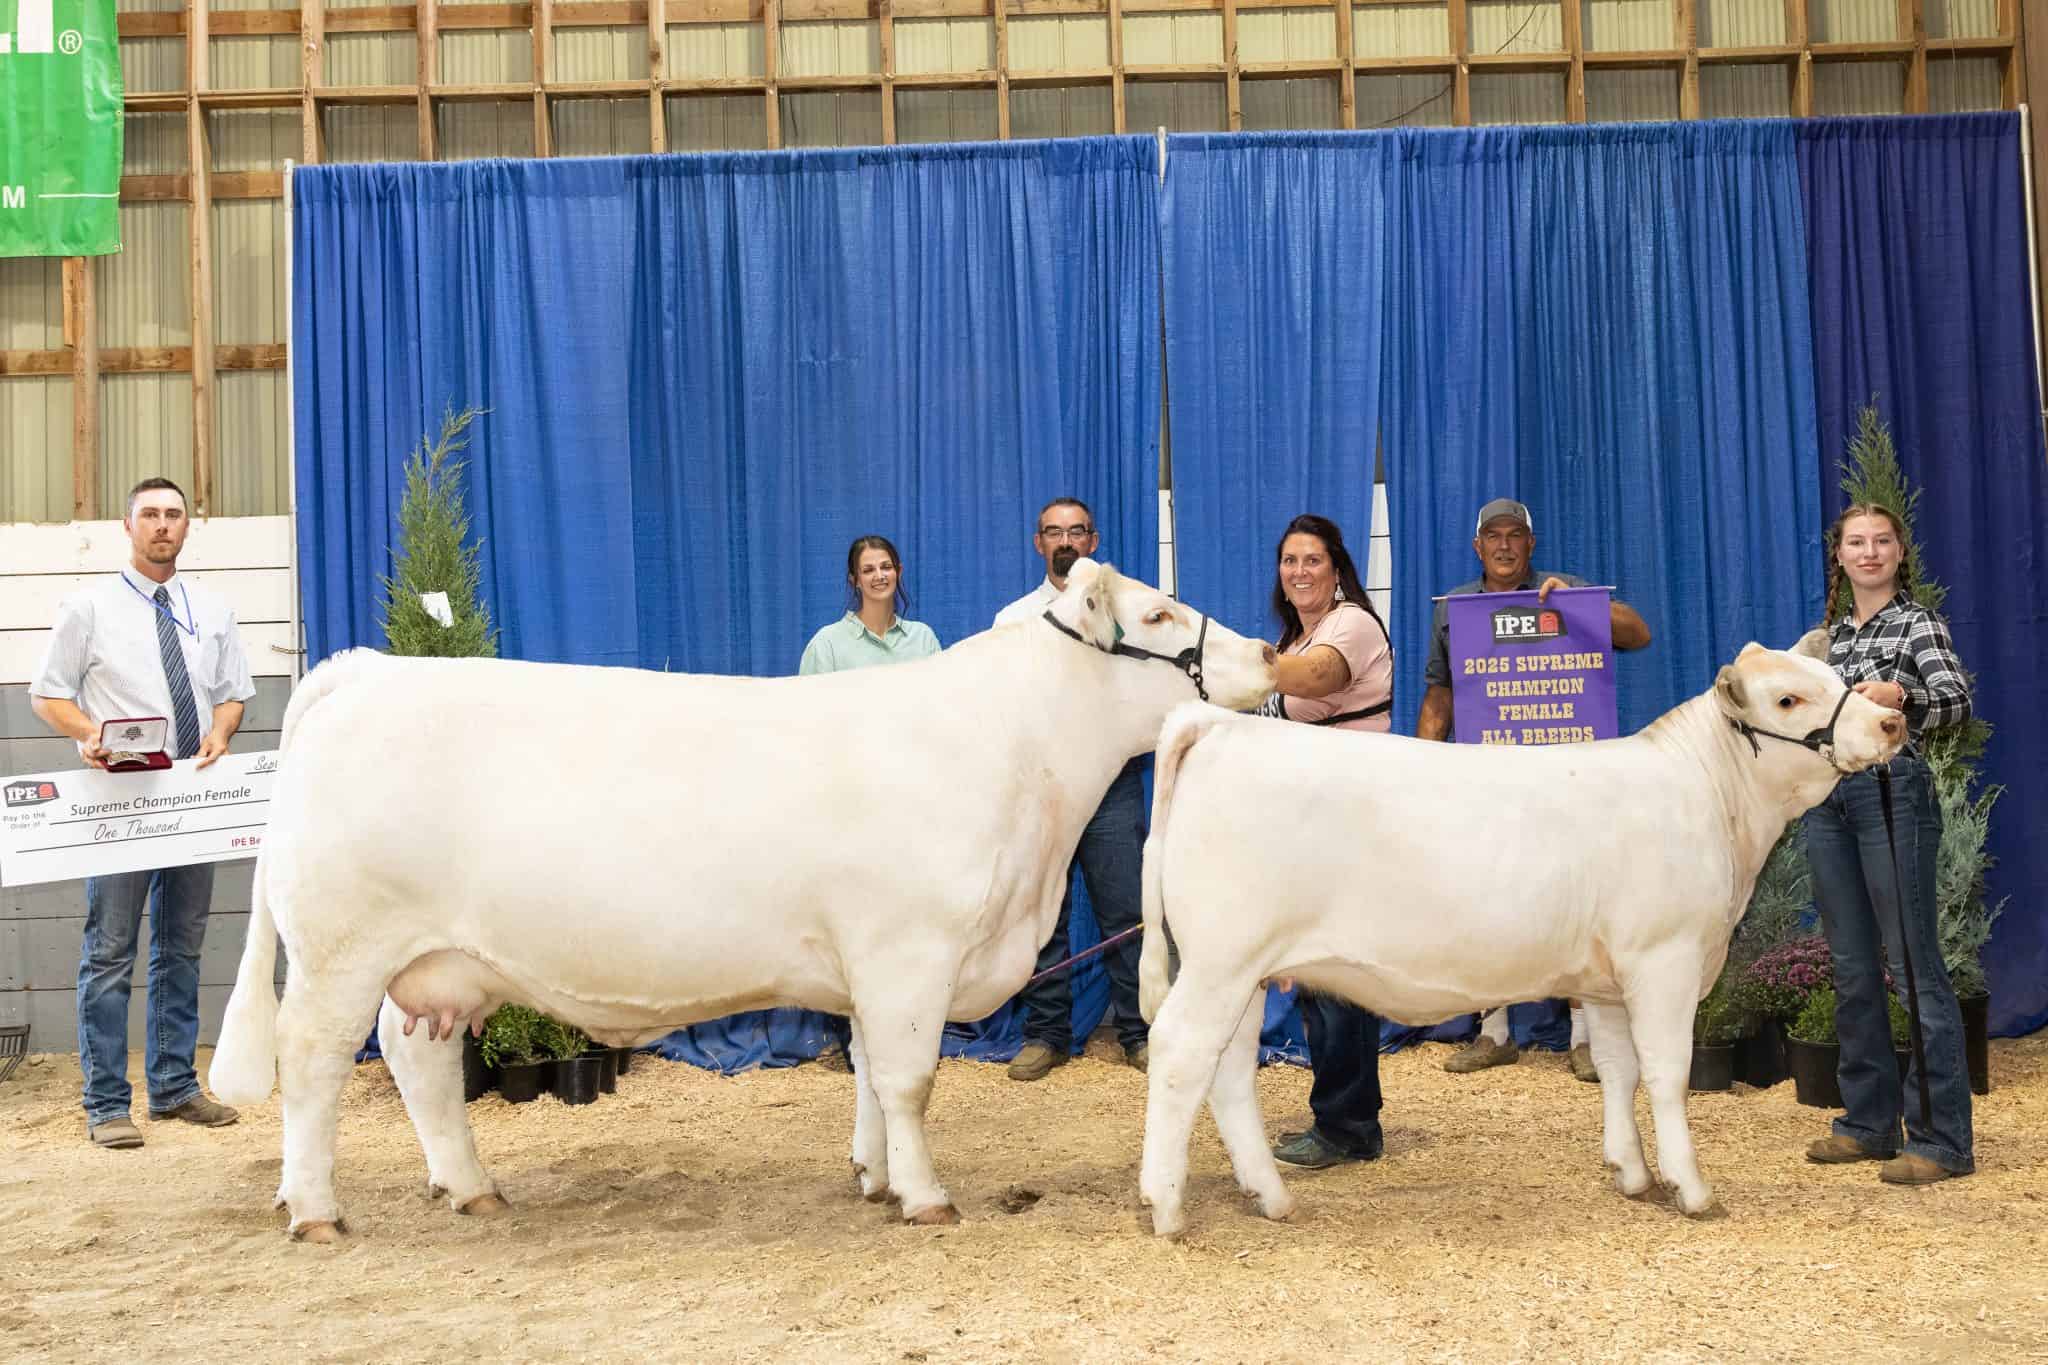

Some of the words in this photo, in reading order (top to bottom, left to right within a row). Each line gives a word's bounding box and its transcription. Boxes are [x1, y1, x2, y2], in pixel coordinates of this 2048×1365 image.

[1495, 616, 1536, 635] IPE
[1464, 656, 1511, 675] 2025
[1516, 652, 1604, 673] SUPREME
[1486, 677, 1585, 698] CHAMPION
[1498, 702, 1574, 721] FEMALE
[1481, 729, 1517, 745] ALL
[1521, 726, 1595, 744] BREEDS
[6, 787, 38, 800] IPE
[70, 803, 130, 817] Supreme
[133, 795, 201, 810] Champion
[204, 786, 252, 801] Female
[94, 824, 118, 841] One
[127, 816, 183, 838] Thousand
[231, 837, 248, 848] IPE
